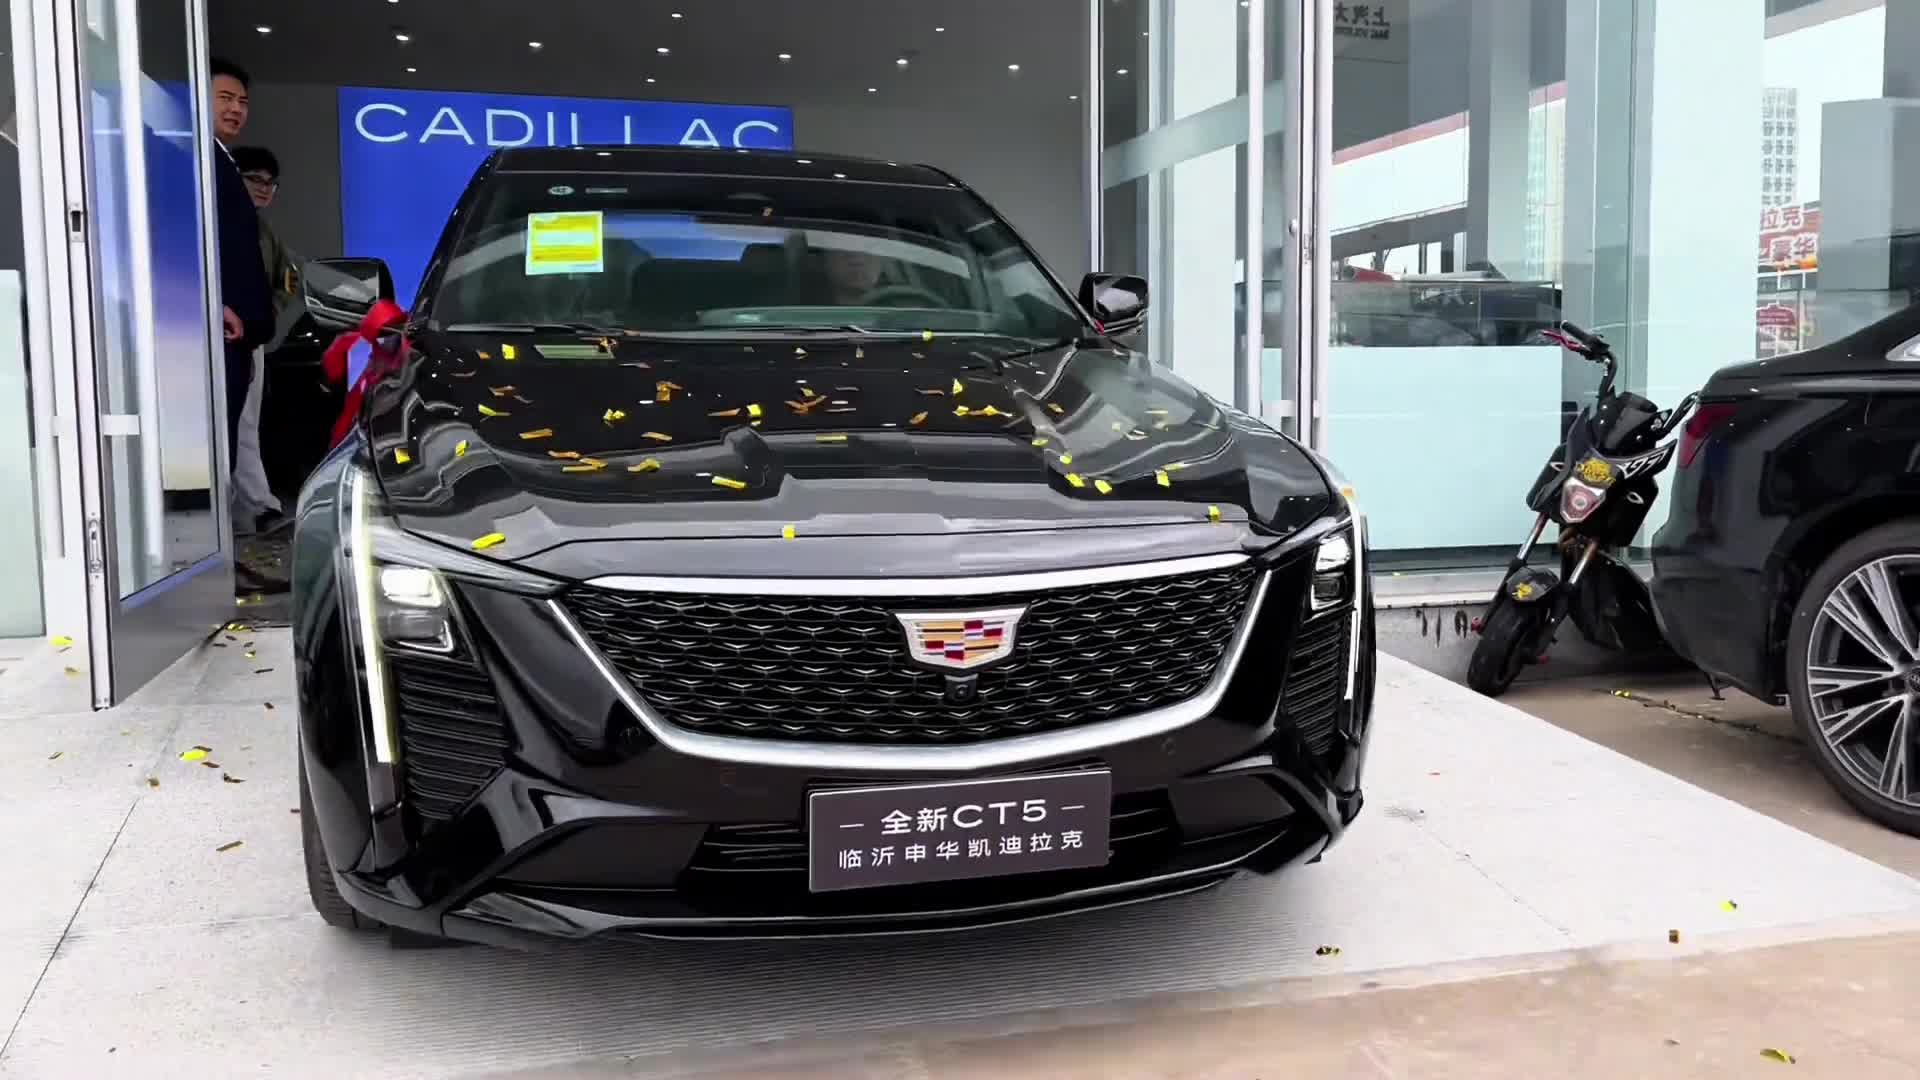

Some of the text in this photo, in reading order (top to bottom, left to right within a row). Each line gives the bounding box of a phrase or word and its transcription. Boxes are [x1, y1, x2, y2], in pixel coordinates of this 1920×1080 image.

[880, 799, 1048, 836] 全新CT5
[838, 830, 1084, 870] 临沂申华凯迪拉克
